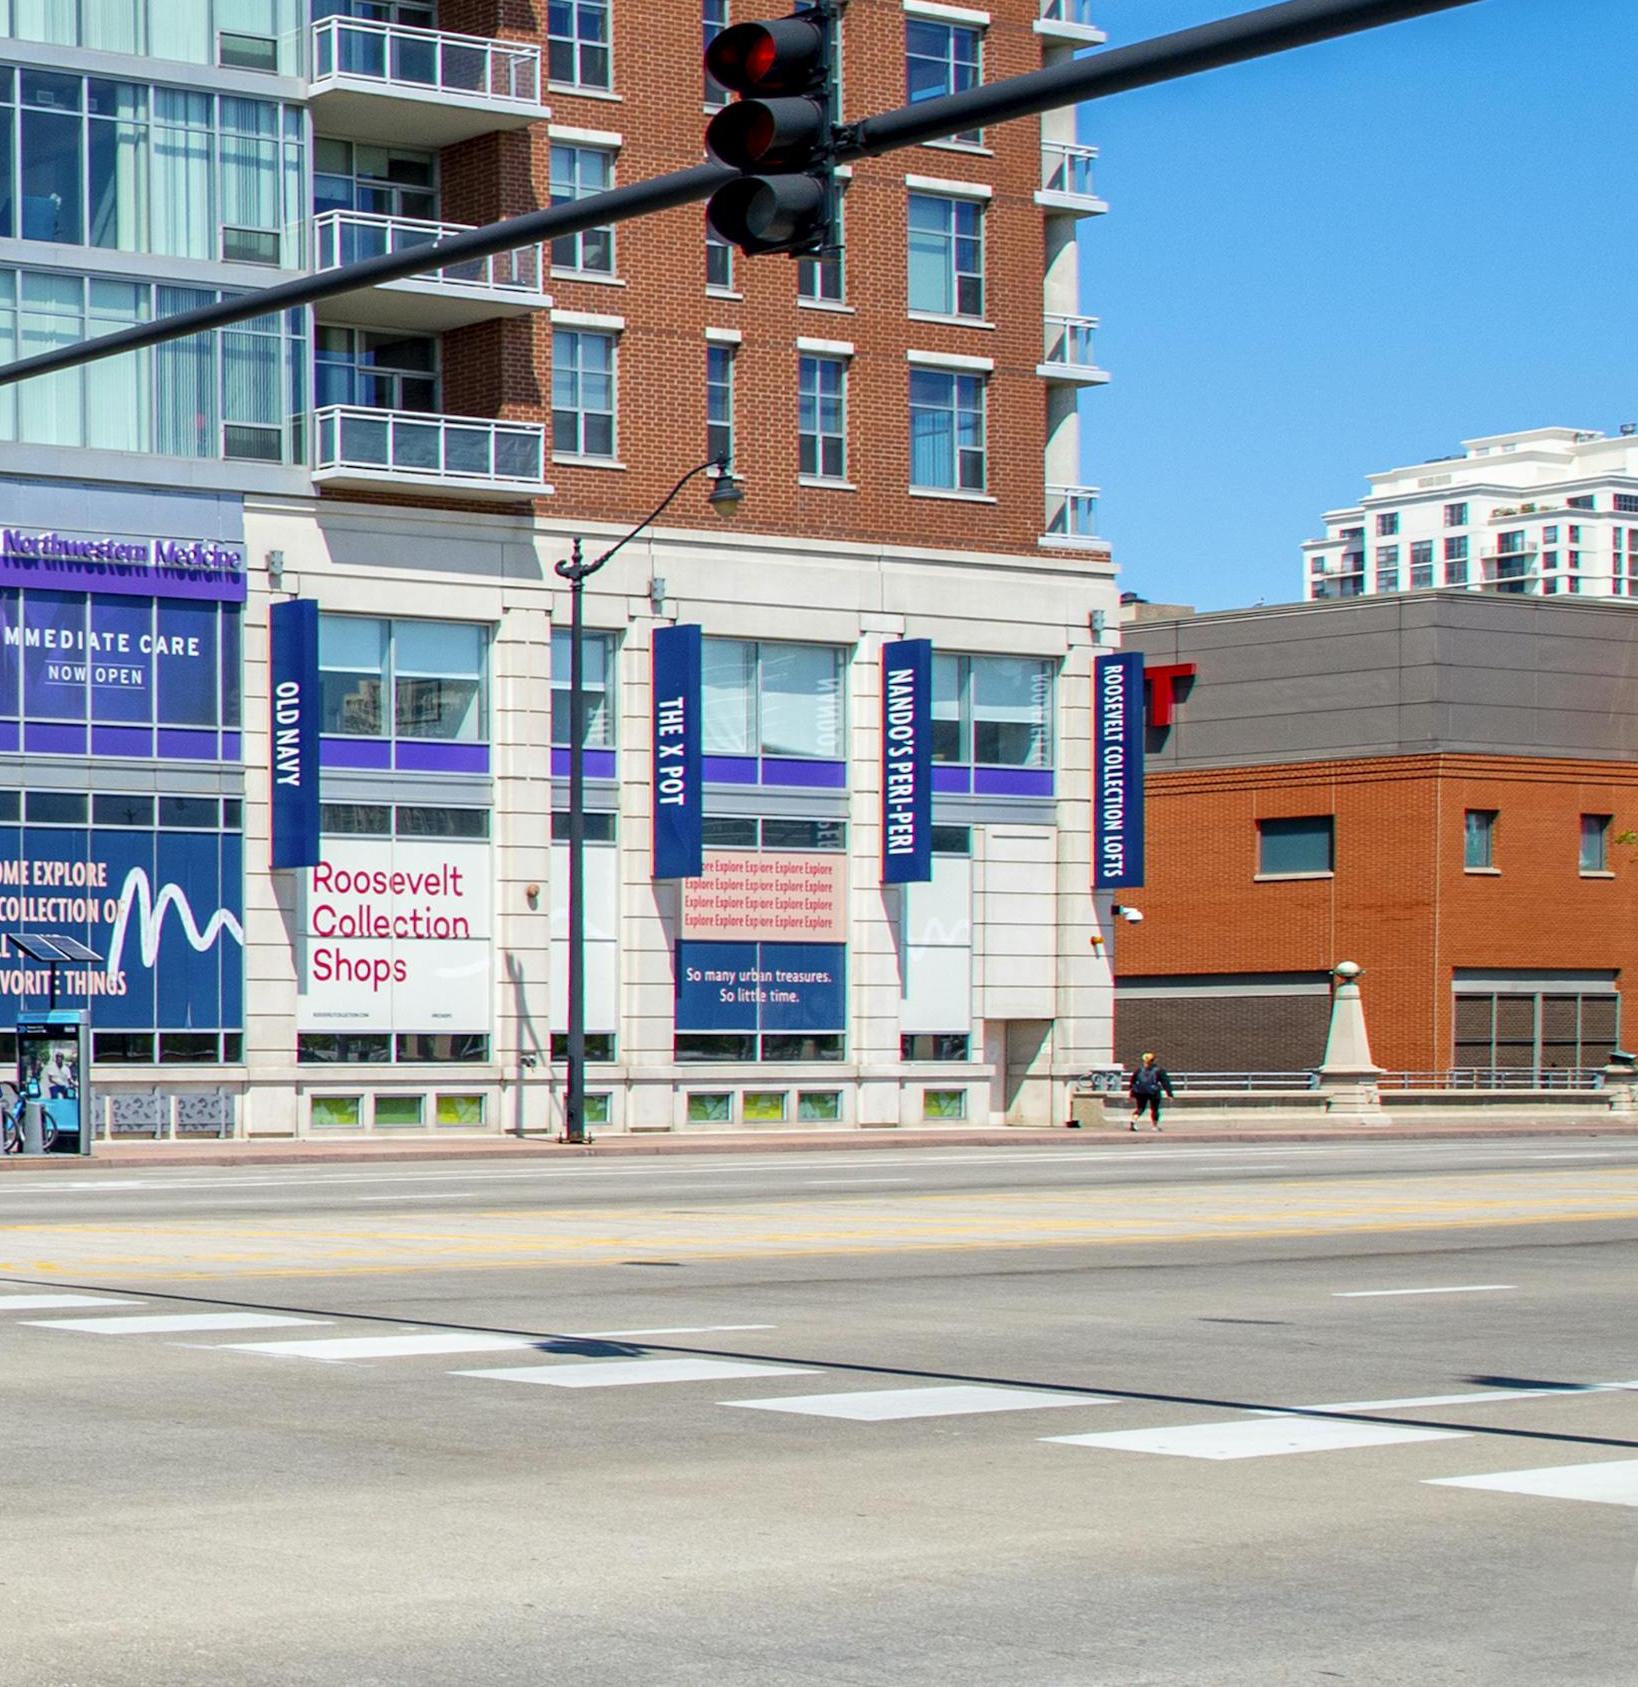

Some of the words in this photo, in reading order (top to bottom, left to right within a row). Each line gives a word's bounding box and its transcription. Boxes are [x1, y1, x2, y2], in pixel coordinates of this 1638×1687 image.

[1, 528, 149, 562] Northwestern
[152, 539, 242, 570] Medicine
[139, 635, 200, 657] CARE
[48, 665, 87, 682] NOW
[95, 668, 142, 685] OPEN
[275, 680, 300, 725] OLD
[659, 697, 684, 736] THE
[888, 669, 914, 757] NANDO'S
[1104, 665, 1124, 741] ROOSEVELT
[276, 728, 300, 787] NAVY
[659, 743, 684, 758] X
[659, 766, 684, 806] POT
[1103, 745, 1124, 831] COLLECTION
[888, 762, 914, 855] PERI-PERI
[33, 861, 108, 888] EXPLORE
[715, 860, 743, 875] Explore
[776, 861, 803, 876] Explore
[805, 862, 832, 876] Explore
[1103, 835, 1124, 878] LOFTS
[313, 861, 463, 897] Roosevelt
[685, 878, 714, 891] Explore
[715, 878, 743, 892] Explore
[776, 879, 803, 894] Explore
[805, 880, 832, 894] Explore
[312, 904, 470, 940] Collection
[685, 896, 714, 910] Explore
[715, 896, 743, 911] Explore
[776, 897, 803, 912] Explore
[805, 898, 832, 913] Explore
[685, 913, 714, 928] Explore
[715, 914, 743, 928] Explore
[776, 915, 803, 930] Explore
[805, 916, 832, 931] Explore
[64, 970, 127, 996] THINGS
[313, 948, 407, 993] Shops
[686, 967, 701, 982] So
[705, 970, 736, 985] many
[739, 968, 772, 982] urban
[776, 970, 832, 983] treasures.
[720, 988, 735, 1002] So
[738, 987, 766, 1002] little
[770, 989, 800, 1003] time.
